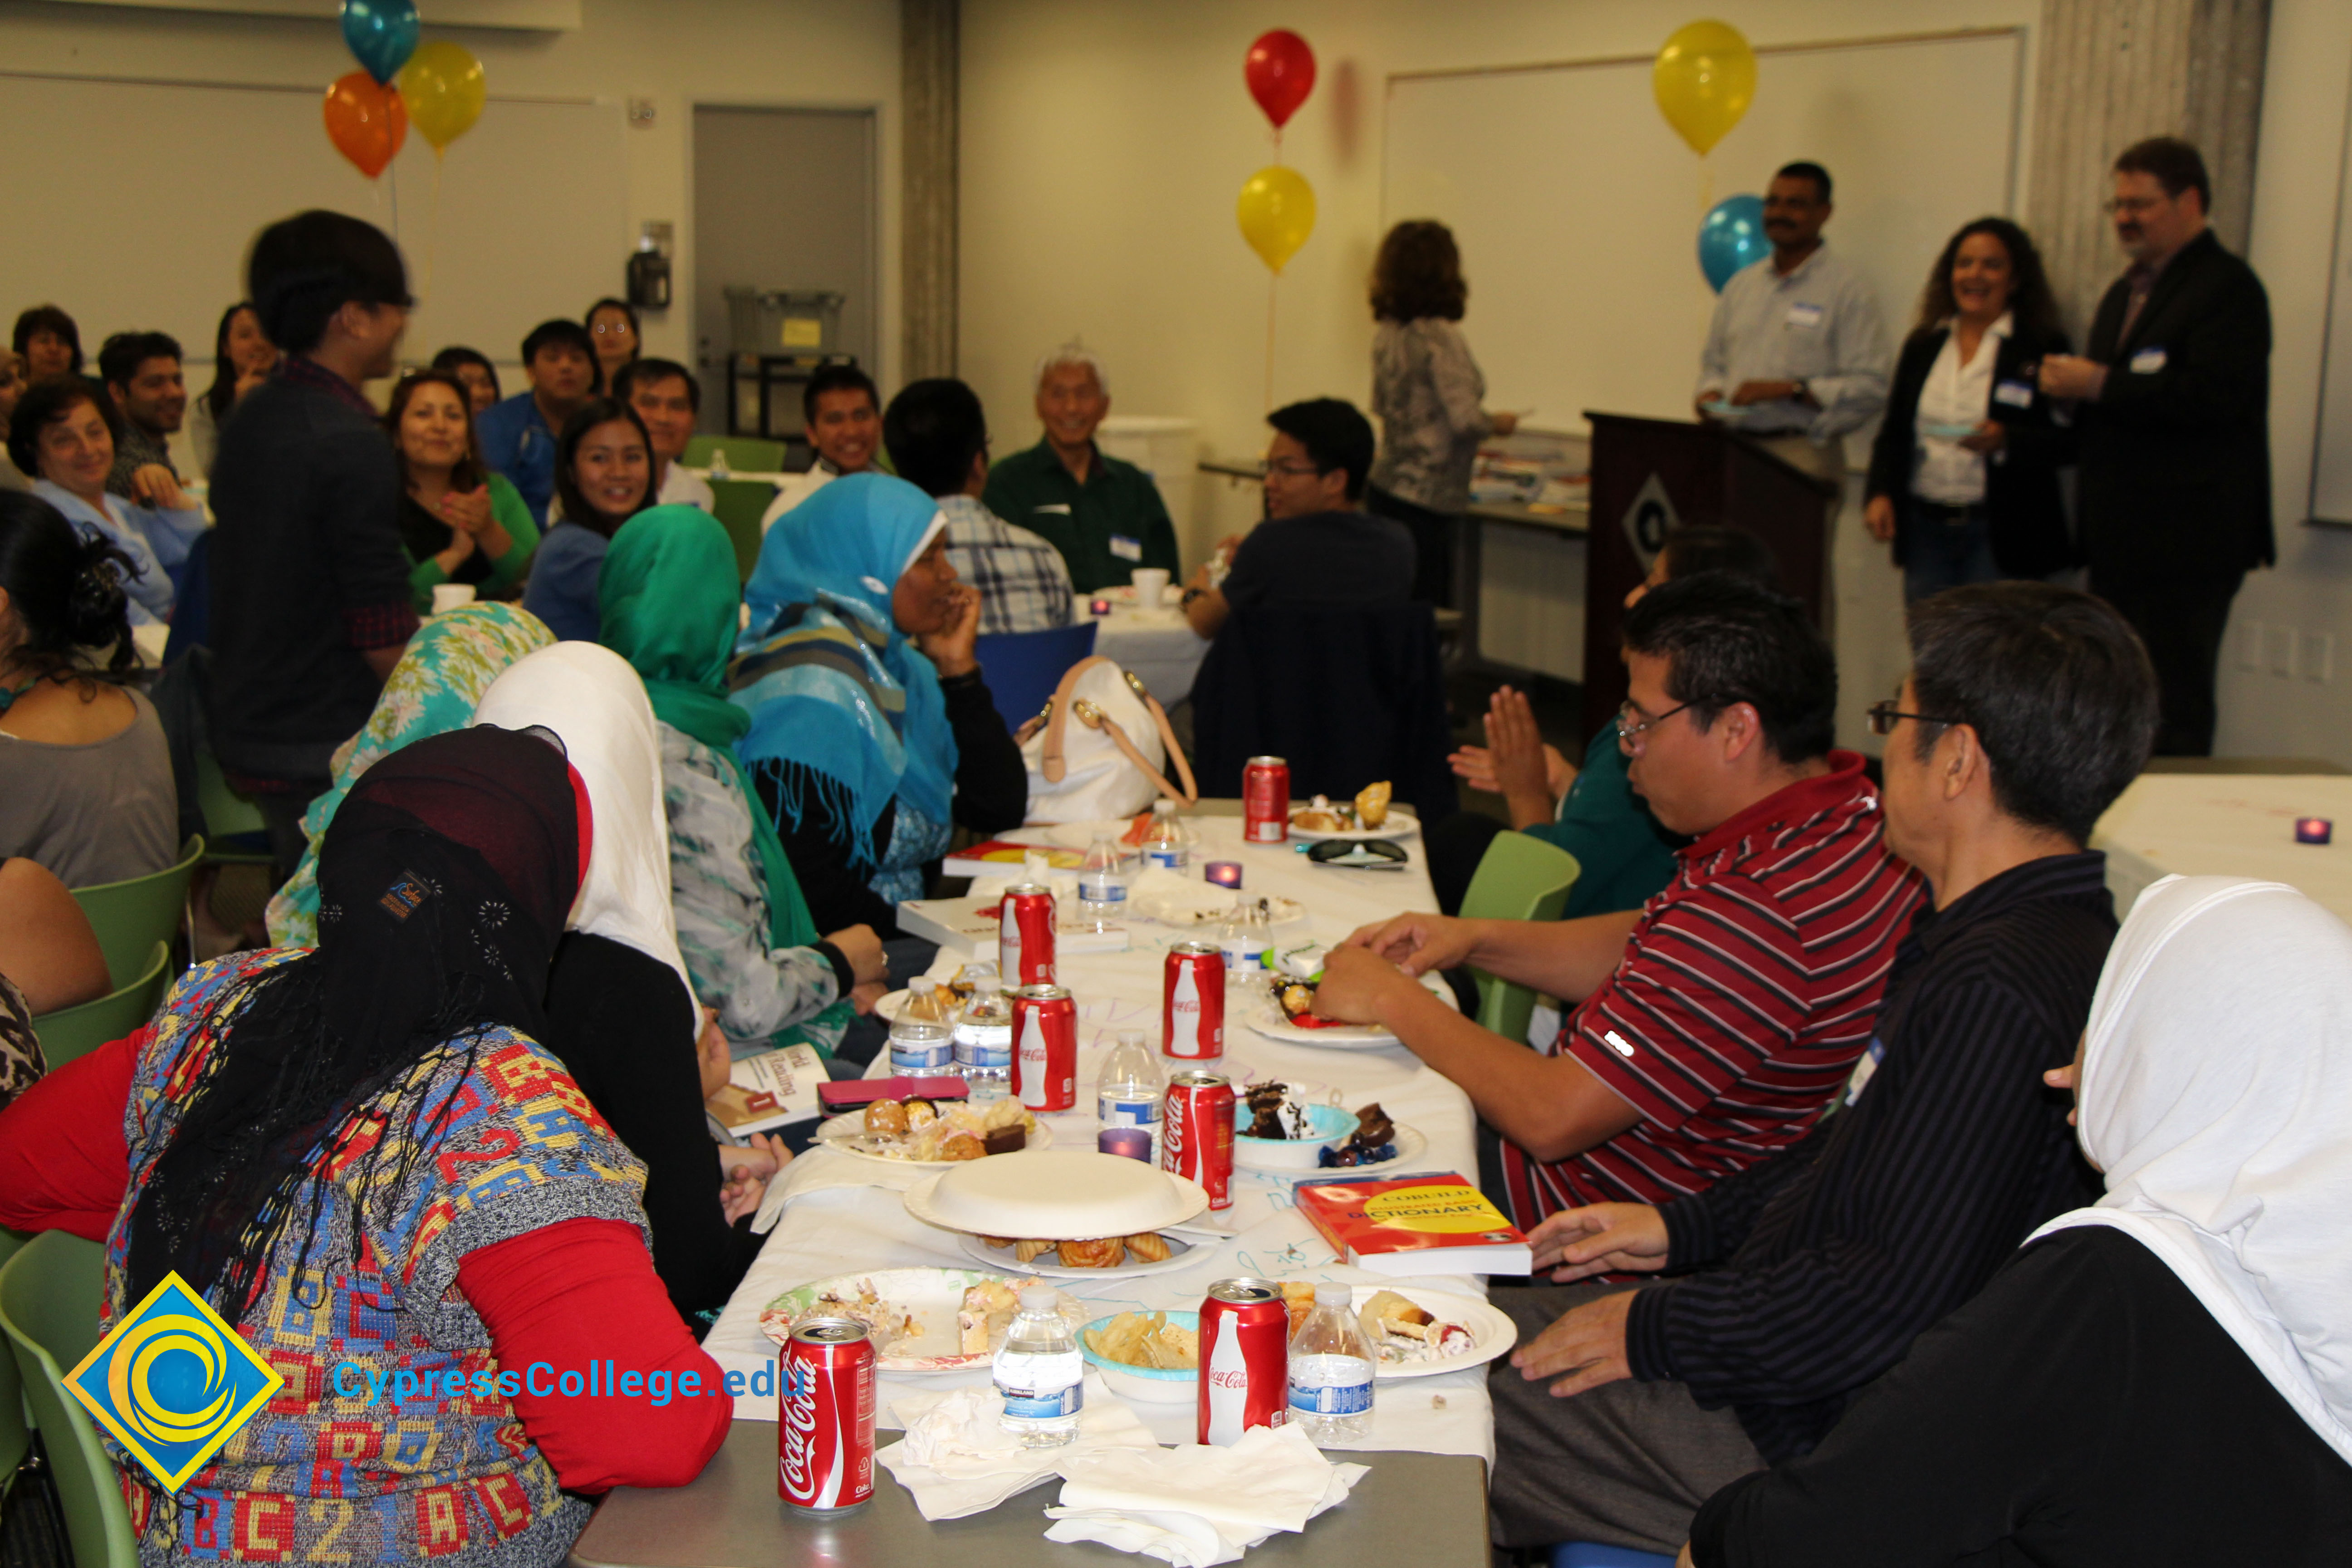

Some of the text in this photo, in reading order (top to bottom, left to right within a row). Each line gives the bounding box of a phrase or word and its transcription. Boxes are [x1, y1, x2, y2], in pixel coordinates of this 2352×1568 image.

[1348, 1203, 1482, 1219] DICTIONARY
[1383, 1190, 1470, 1201] COBUILD
[780, 1342, 816, 1500] Coca-Cola
[248, 1500, 280, 1550] C
[306, 1499, 353, 1562] 2
[426, 1491, 459, 1543] A
